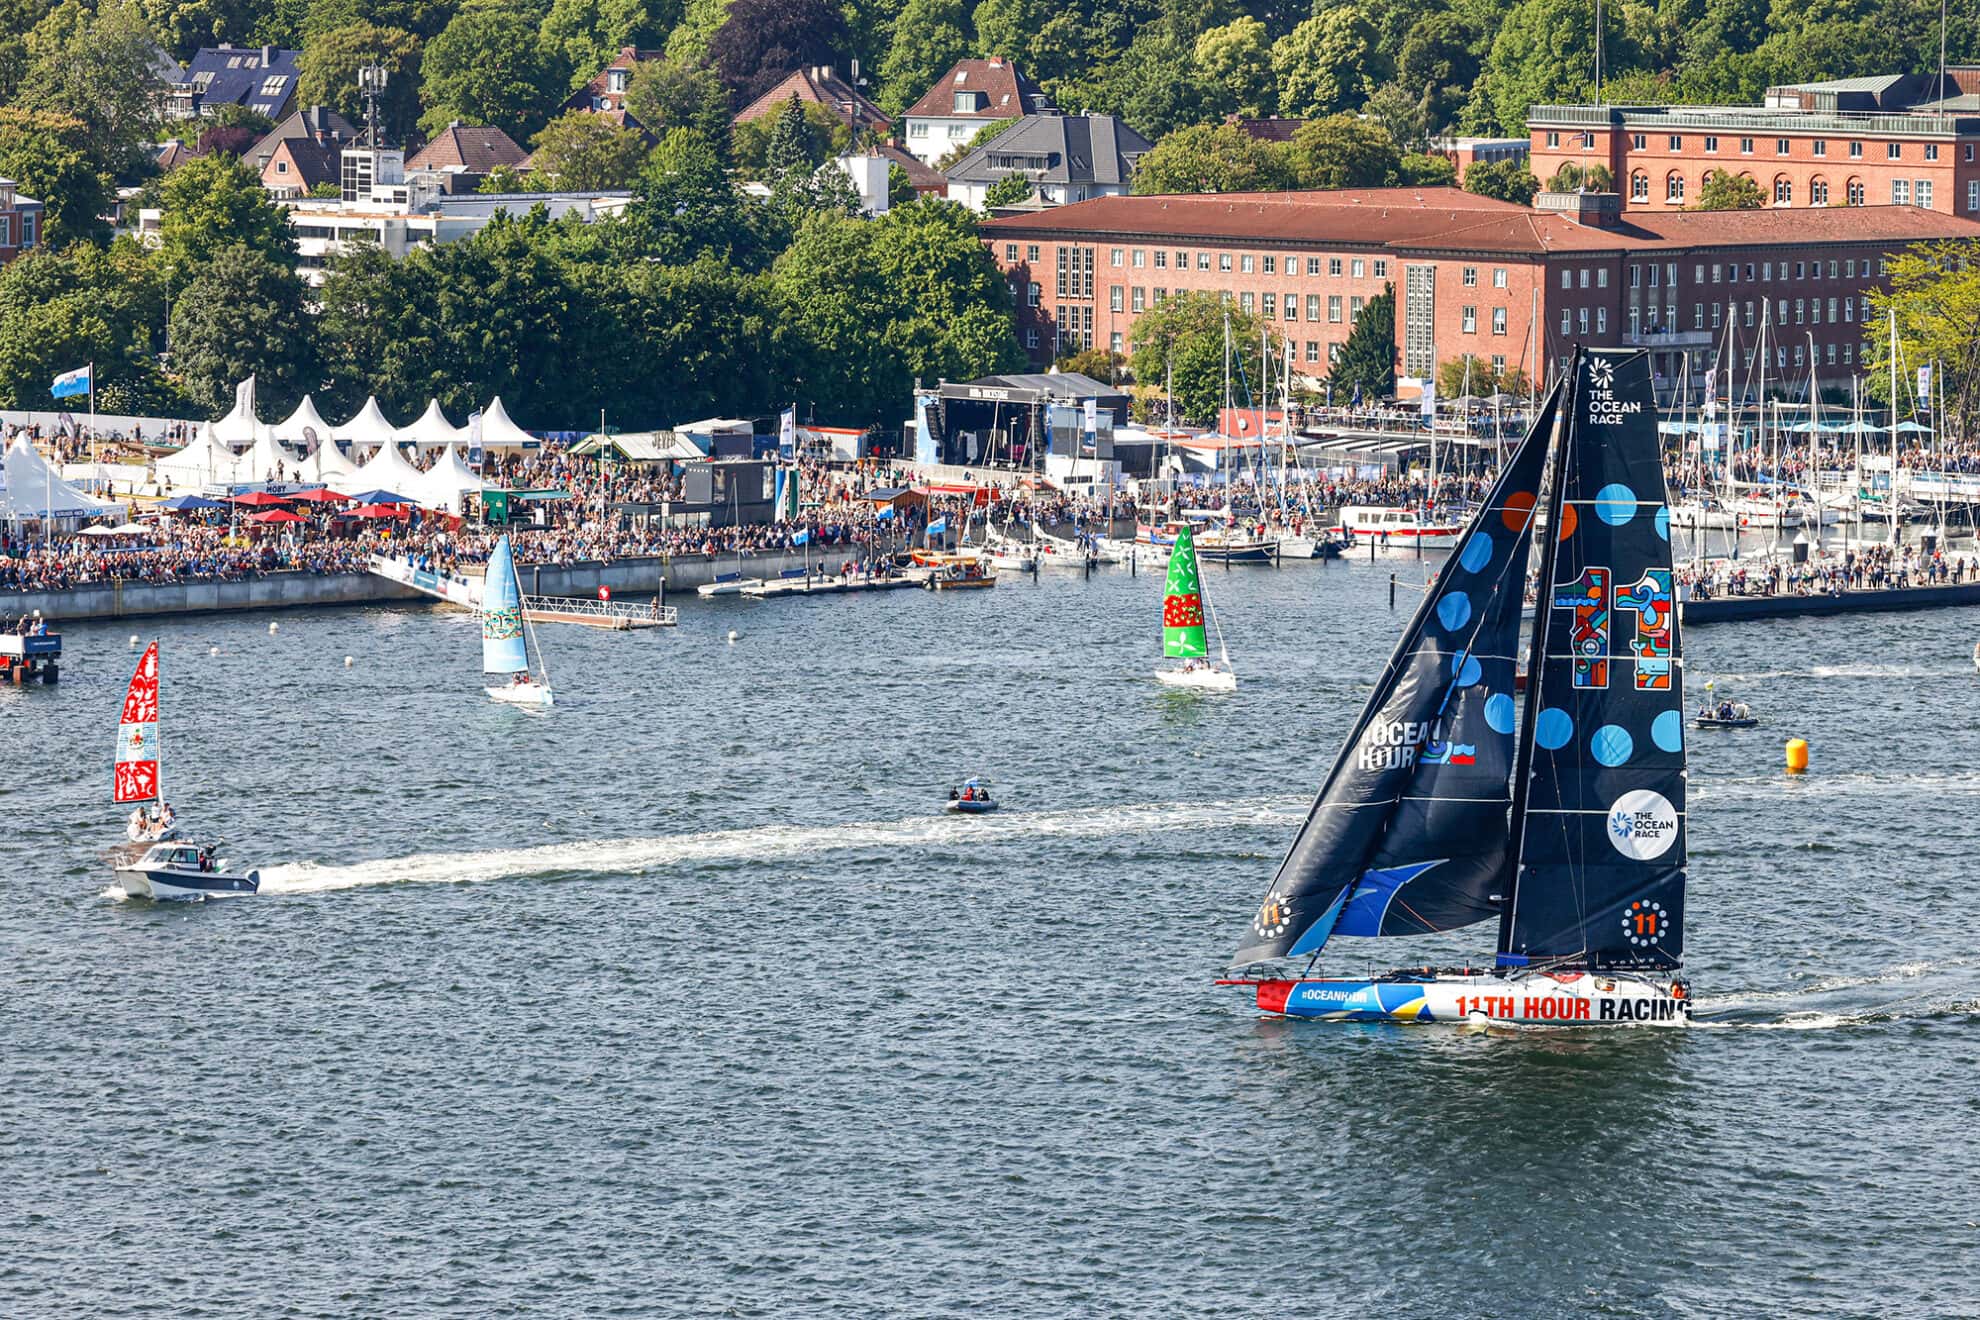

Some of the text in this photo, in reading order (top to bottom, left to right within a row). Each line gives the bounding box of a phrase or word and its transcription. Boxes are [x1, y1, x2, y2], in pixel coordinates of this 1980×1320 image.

[1589, 390, 1613, 400] THE
[1589, 401, 1641, 413] OCEAN
[1589, 414, 1624, 425] RACE
[1634, 812, 1654, 821] THE
[1634, 820, 1674, 830] OCEAN
[1634, 830, 1661, 839] RACE
[1633, 913, 1657, 935] 11
[1455, 996, 1515, 1019] 11TH
[1524, 997, 1592, 1020] HOUR
